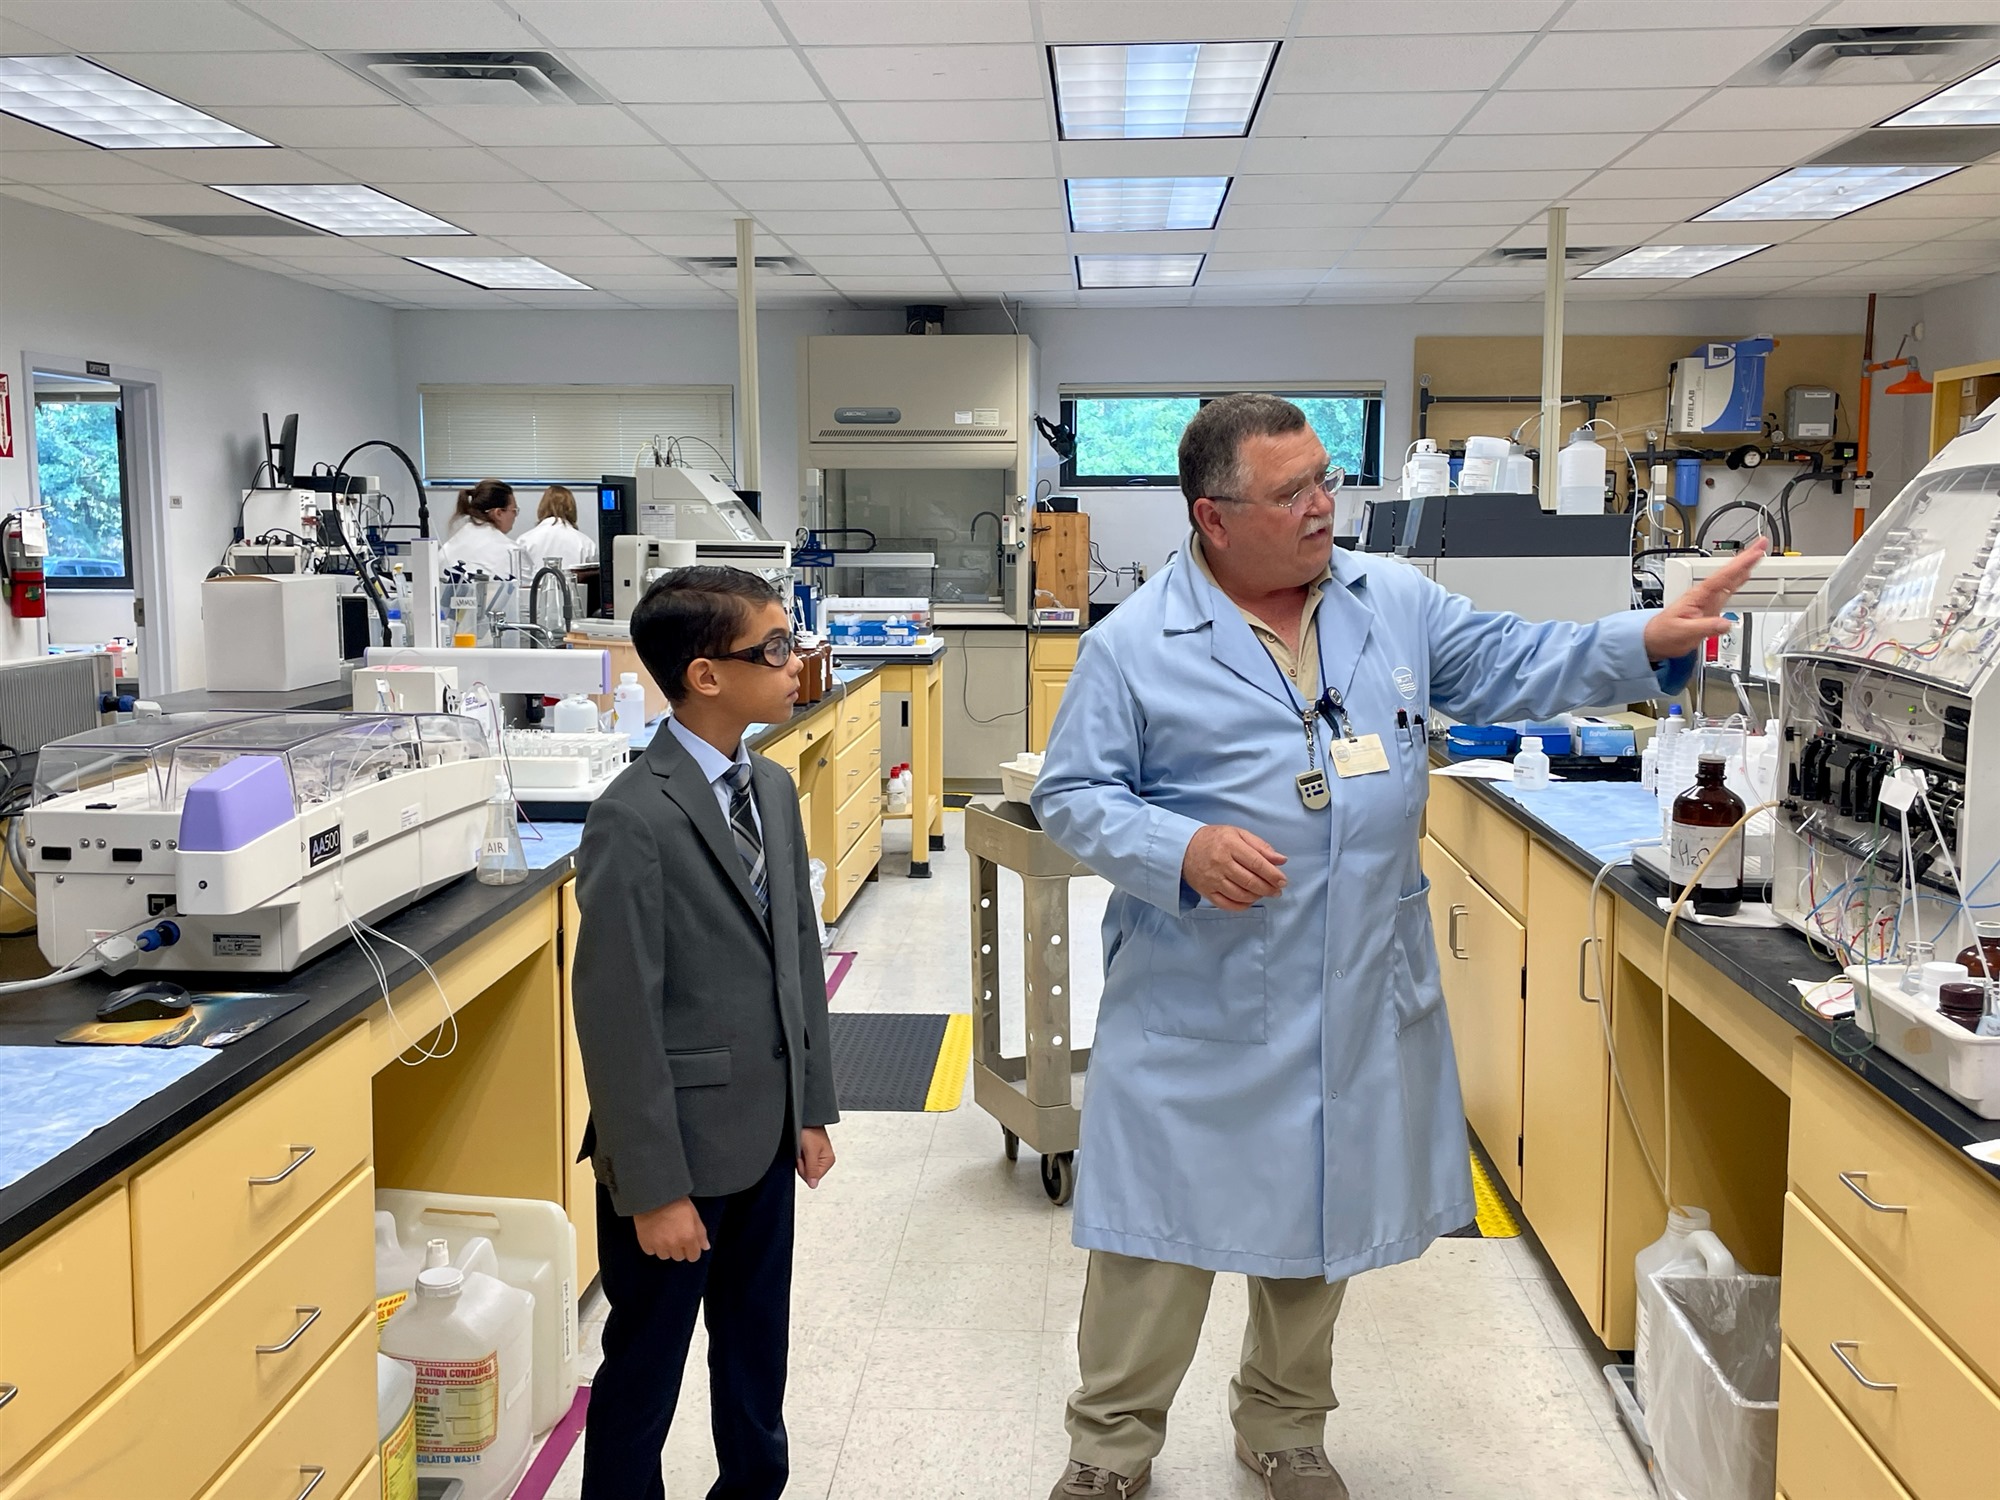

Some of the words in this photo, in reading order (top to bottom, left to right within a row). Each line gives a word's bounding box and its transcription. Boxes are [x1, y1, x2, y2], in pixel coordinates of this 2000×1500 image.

[1686, 389, 1695, 428] PURELAB
[312, 830, 339, 857] AA500
[487, 841, 506, 853] AIR
[416, 1454, 451, 1464] GULATED
